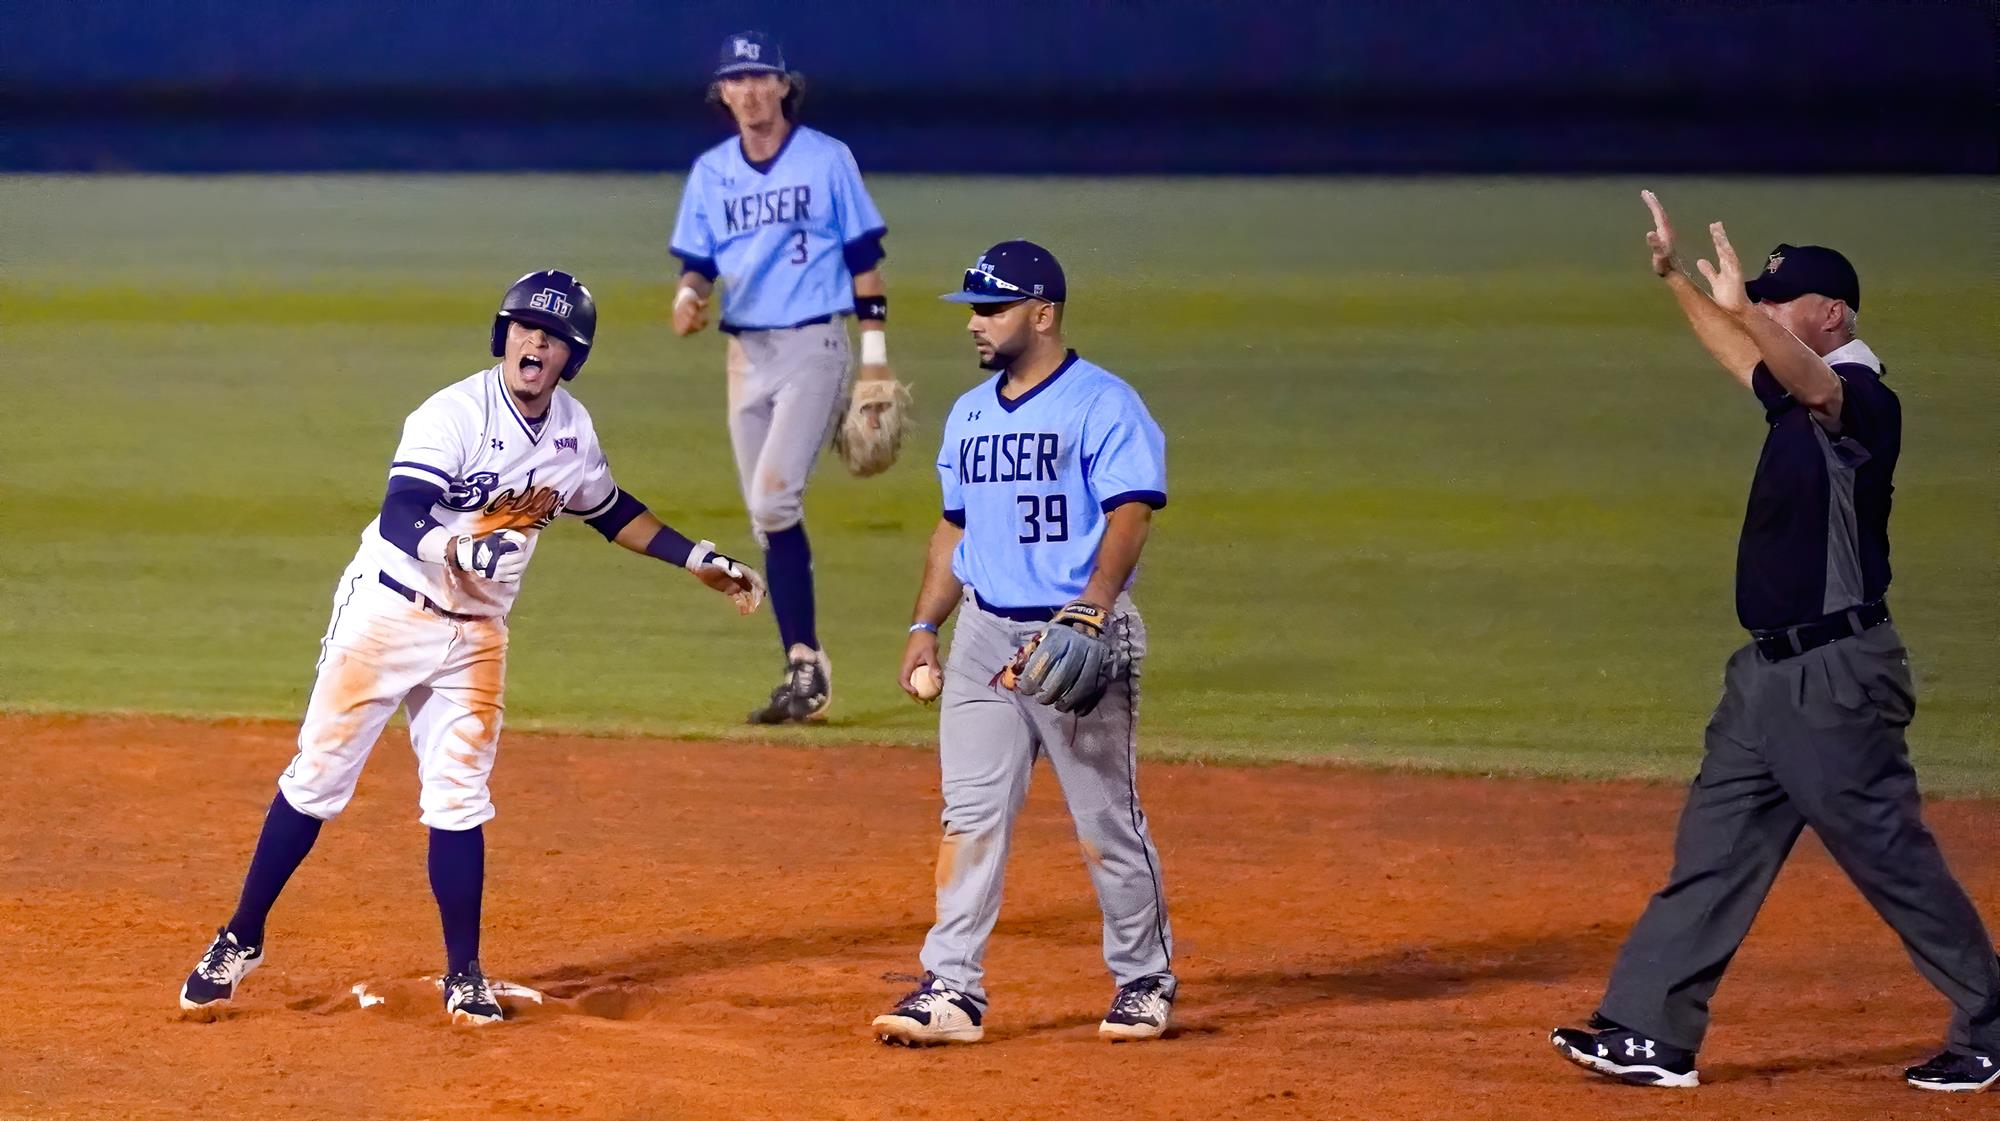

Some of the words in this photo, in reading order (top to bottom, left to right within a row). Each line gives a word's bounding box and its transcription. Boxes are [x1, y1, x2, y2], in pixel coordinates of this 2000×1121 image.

[723, 185, 811, 234] KEISER
[790, 230, 808, 264] 3
[530, 287, 573, 318] STU
[960, 433, 1059, 485] KEISER
[1017, 494, 1068, 543] 39
